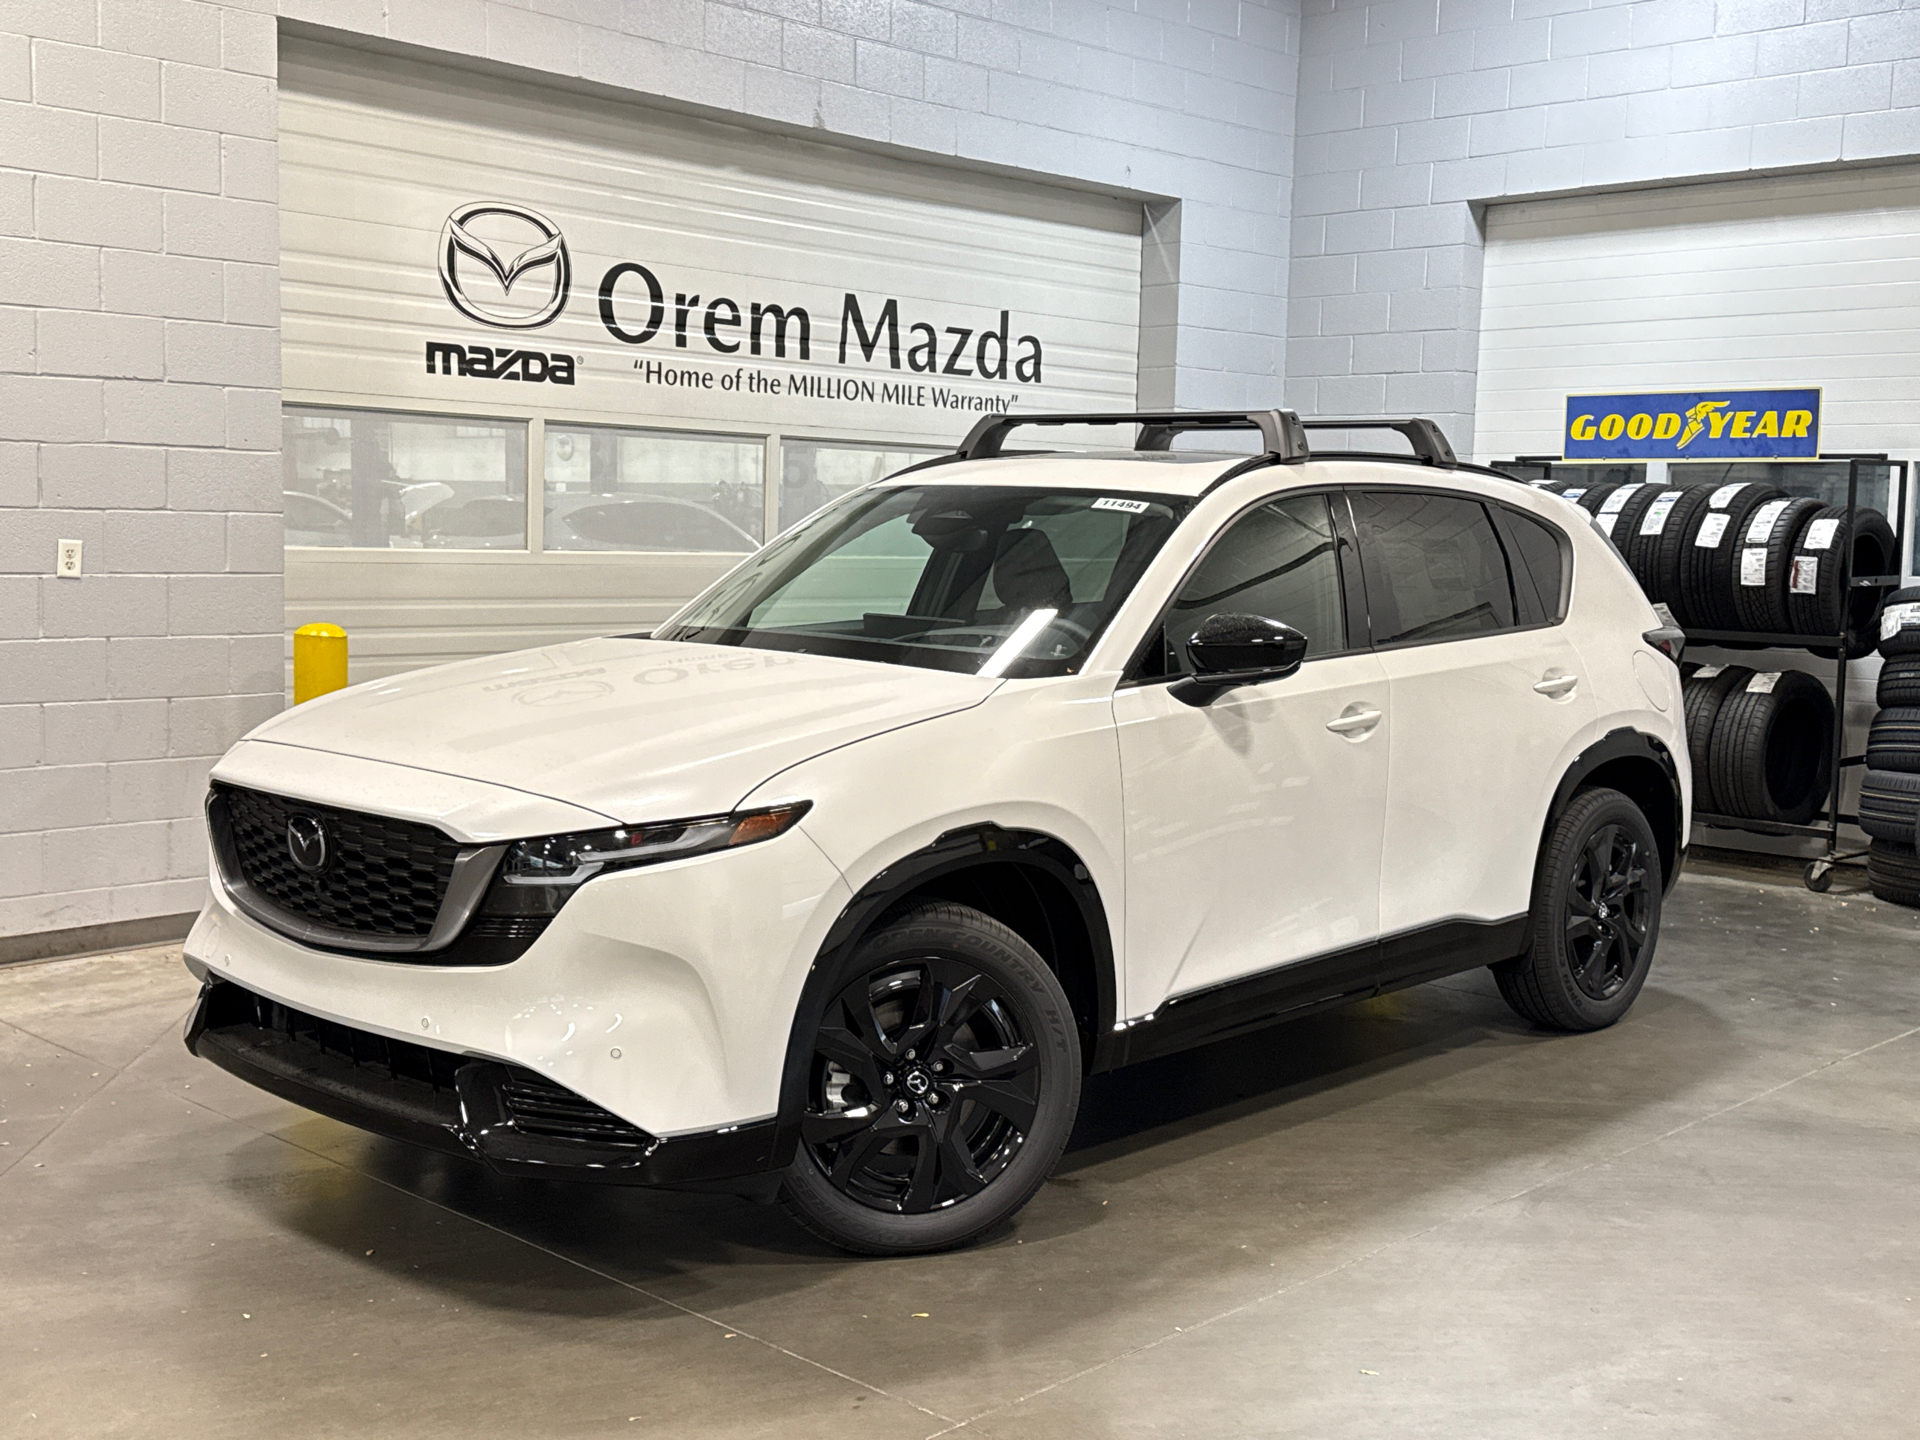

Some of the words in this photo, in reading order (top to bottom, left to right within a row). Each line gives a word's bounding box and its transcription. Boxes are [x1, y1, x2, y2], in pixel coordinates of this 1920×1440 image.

[598, 262, 811, 360] Orem
[838, 292, 1043, 384] Mazda
[425, 341, 576, 386] mazda
[720, 367, 744, 392] of
[748, 369, 782, 395] the
[787, 373, 875, 403] MILLION
[880, 382, 926, 407] MILE
[1102, 499, 1143, 510] 11494
[871, 926, 943, 950] OPEN
[949, 929, 1046, 995] COUNTRY
[1044, 1009, 1069, 1053] H/T
